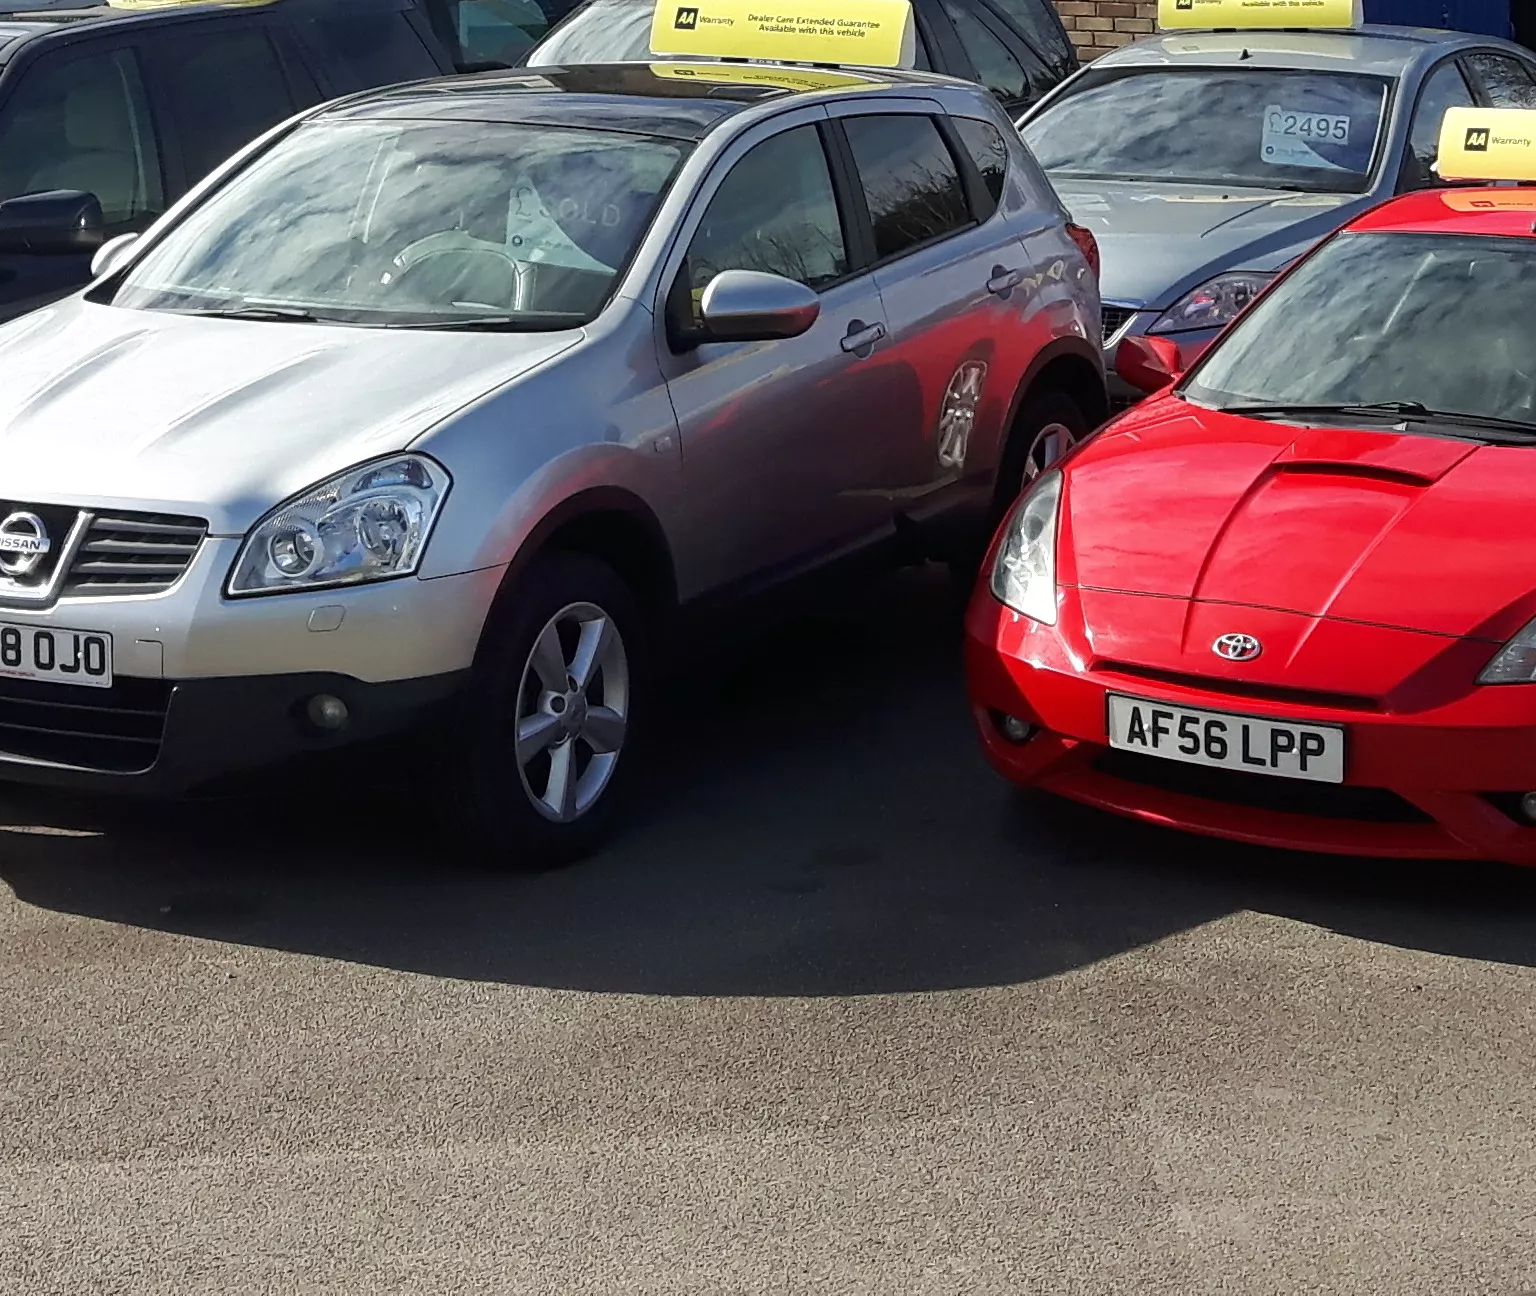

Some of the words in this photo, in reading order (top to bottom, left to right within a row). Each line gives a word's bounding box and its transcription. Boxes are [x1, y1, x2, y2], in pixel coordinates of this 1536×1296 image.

[33, 631, 106, 676] OJO
[1126, 706, 1228, 760] AF56
[1242, 724, 1325, 772] LPP
